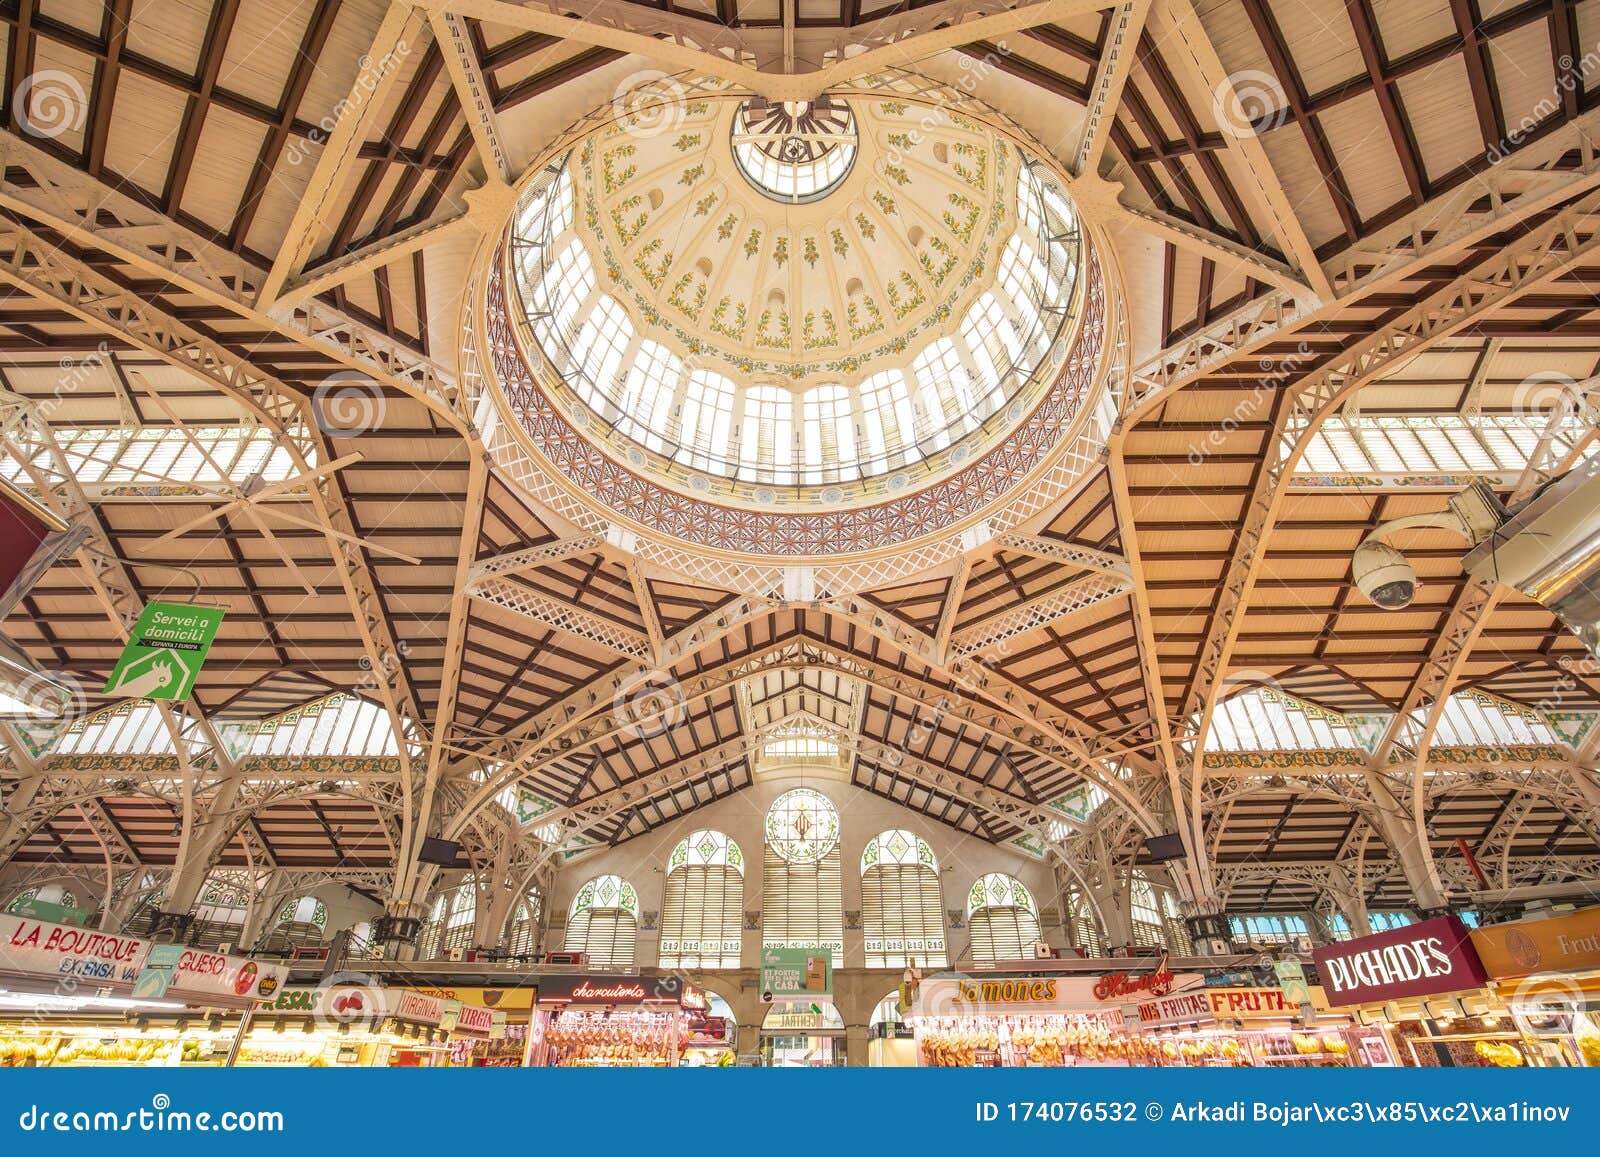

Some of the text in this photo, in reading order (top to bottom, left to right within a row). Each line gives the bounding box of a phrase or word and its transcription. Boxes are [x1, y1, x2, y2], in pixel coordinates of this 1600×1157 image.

[152, 611, 209, 628] Servei a
[145, 626, 205, 641] domicili
[9, 921, 41, 947] LA
[44, 927, 141, 962] BOUTIQUE
[178, 951, 226, 975] QUESO
[59, 957, 116, 980] EXTENSA
[1325, 937, 1452, 992] PUCHADES
[774, 981, 800, 990] CASA
[952, 978, 1057, 1001] Jamones
[401, 994, 437, 1018] VIRGINIA
[1161, 993, 1211, 1018] FRUTAS
[1210, 990, 1301, 1012] FRUTA
